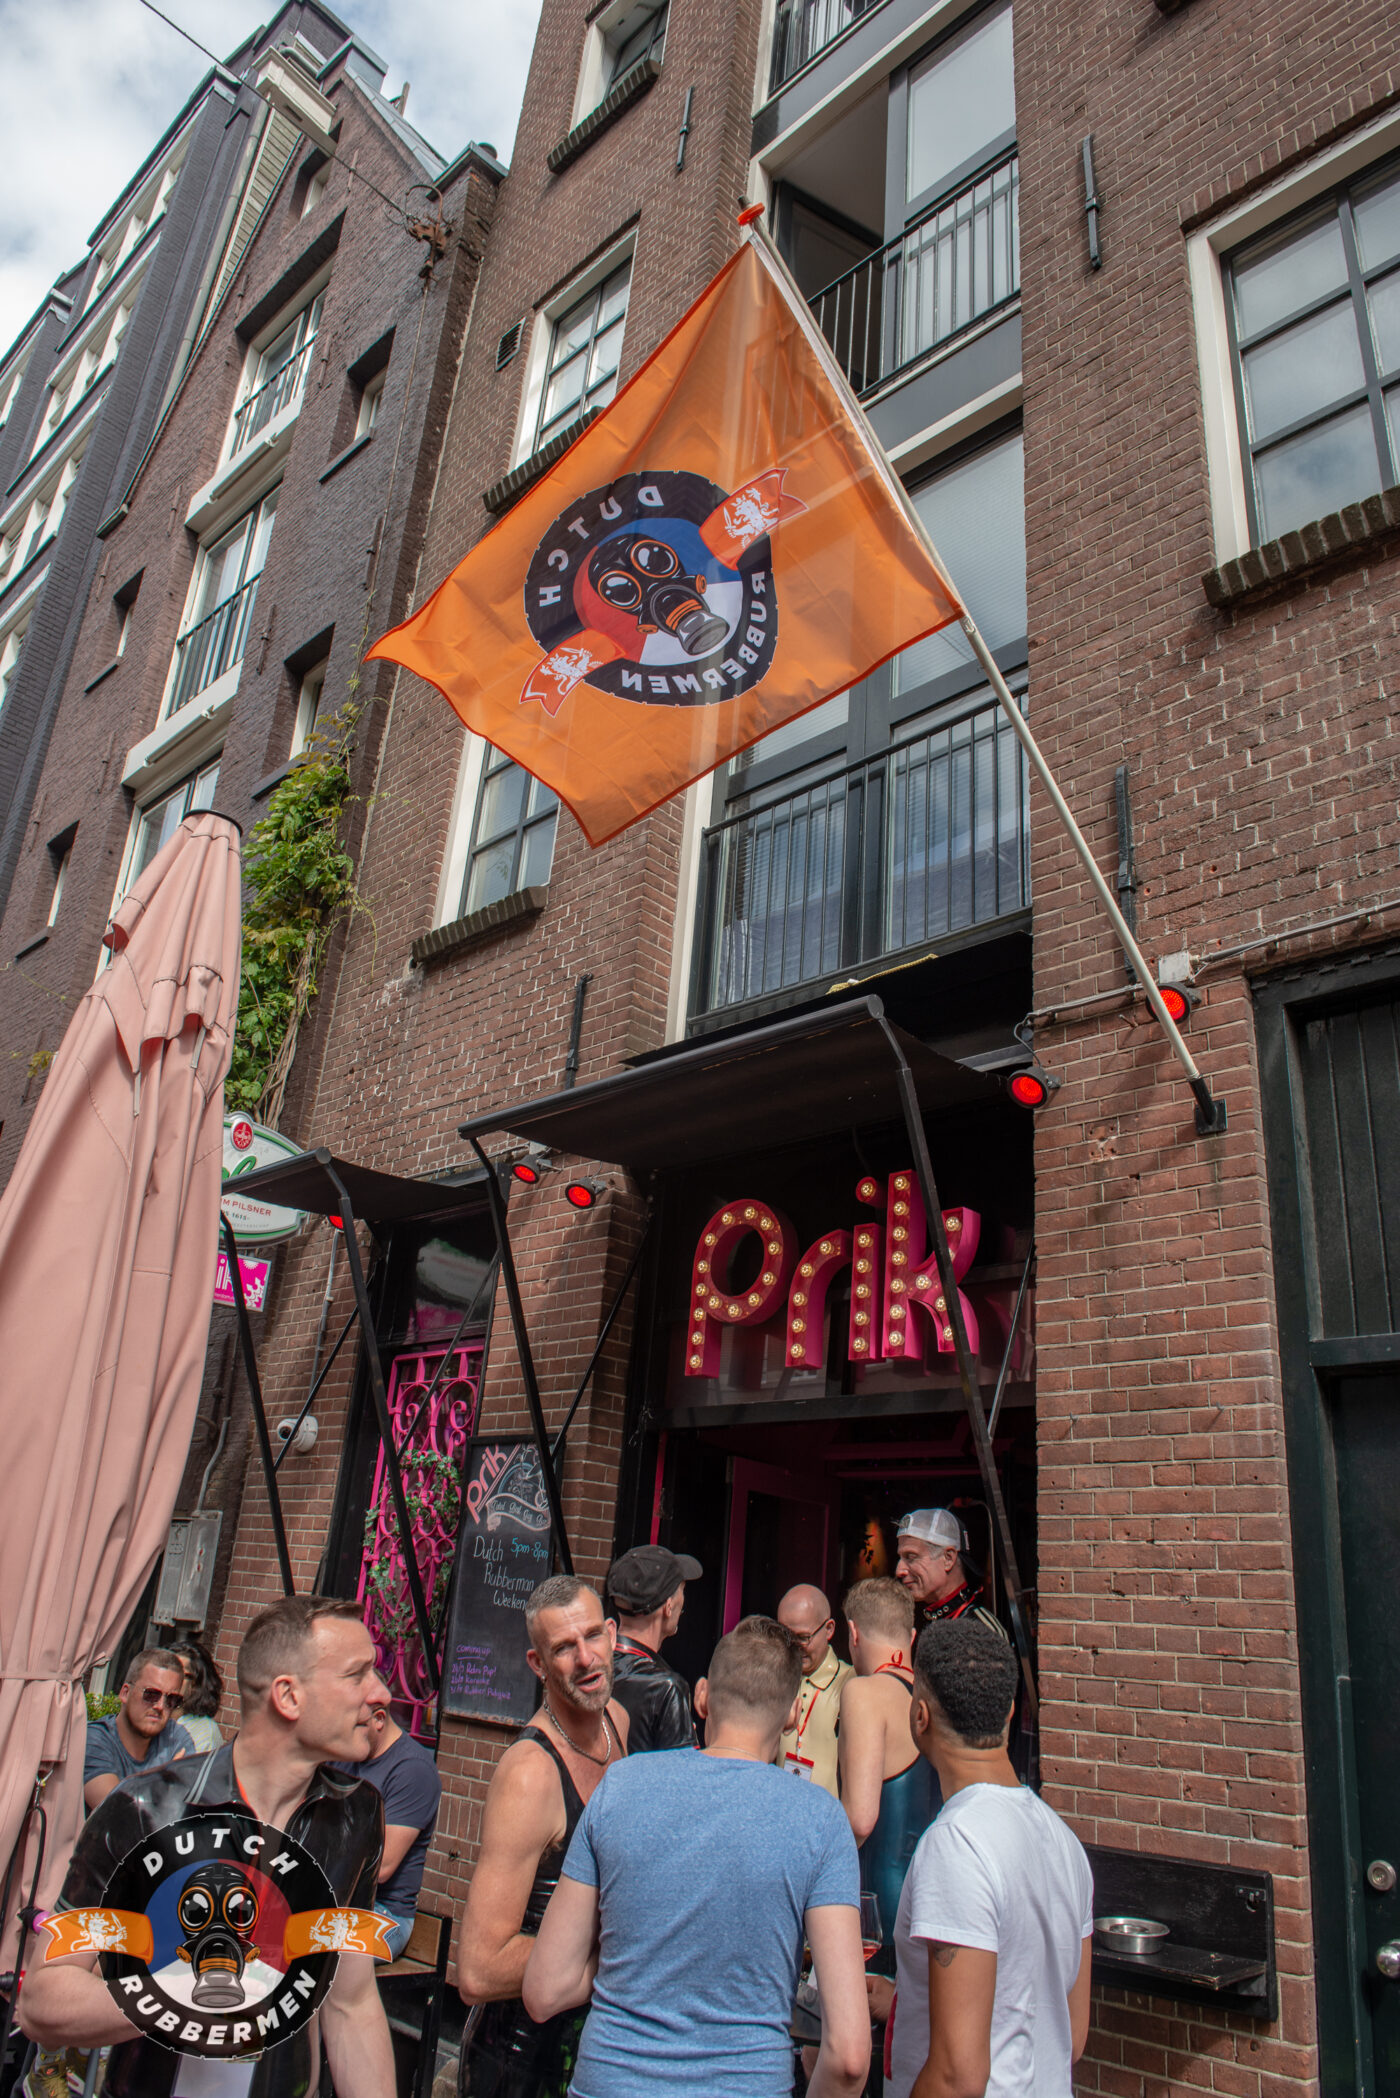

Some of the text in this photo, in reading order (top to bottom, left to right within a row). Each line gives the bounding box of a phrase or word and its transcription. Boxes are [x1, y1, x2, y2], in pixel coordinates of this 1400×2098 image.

[232, 1200, 272, 1216] PILSNER
[473, 1535, 504, 1561] Dutch
[484, 1562, 535, 1591] Rubberman
[493, 1590, 528, 1611] Weeken
